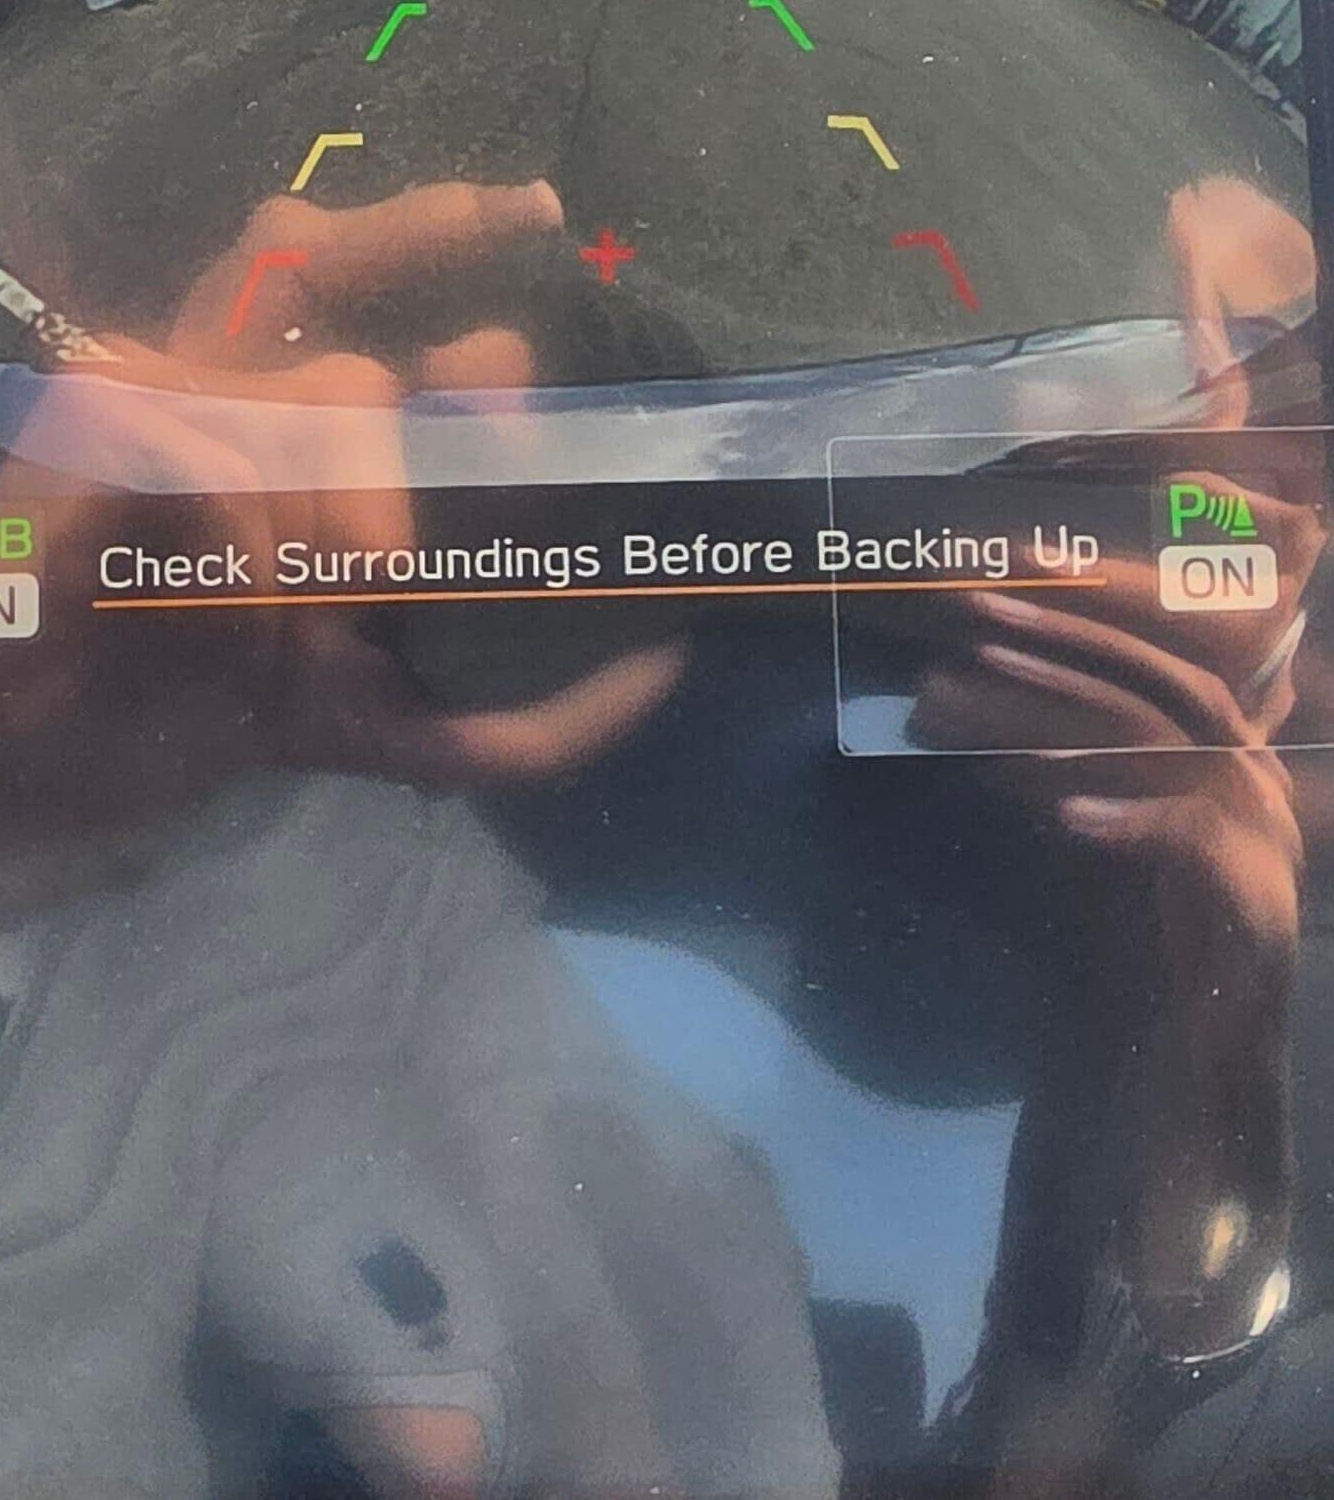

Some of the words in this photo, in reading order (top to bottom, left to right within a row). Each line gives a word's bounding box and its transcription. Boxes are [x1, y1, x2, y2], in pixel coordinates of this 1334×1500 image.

[99, 543, 253, 589] Check
[275, 536, 602, 588] Surroundings
[623, 532, 794, 577] Before
[816, 527, 1011, 579] Backing
[1033, 525, 1100, 577] Up
[1180, 556, 1255, 600] ON
